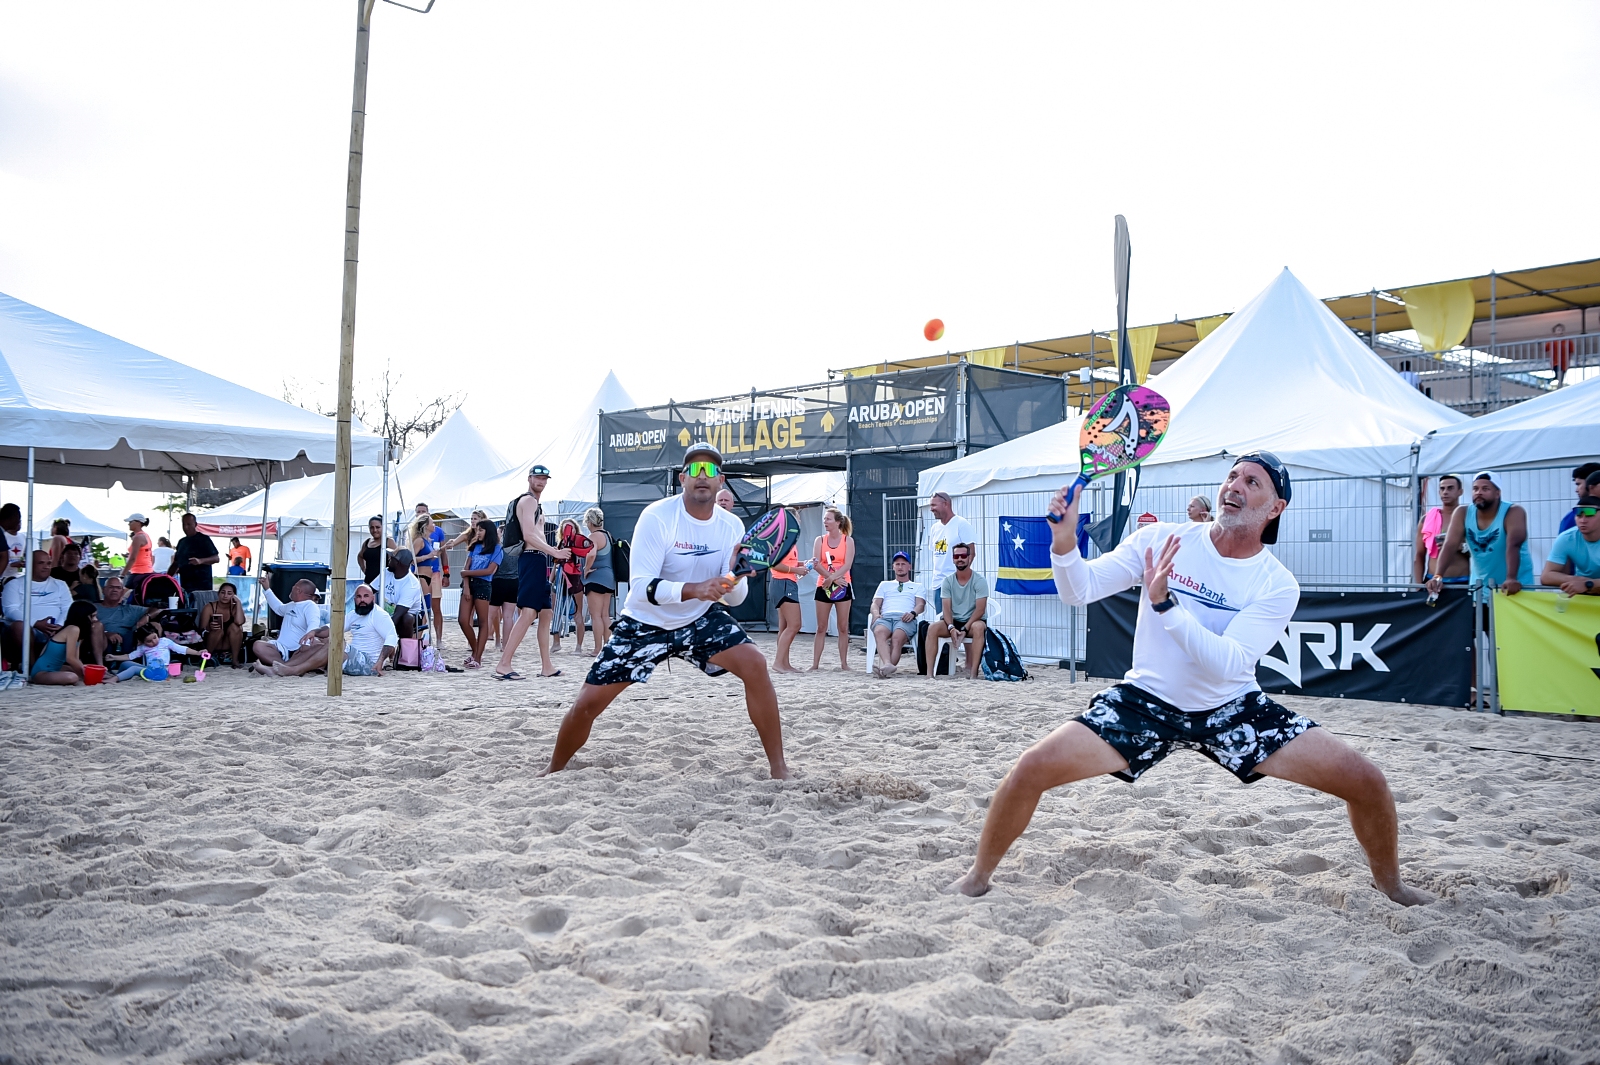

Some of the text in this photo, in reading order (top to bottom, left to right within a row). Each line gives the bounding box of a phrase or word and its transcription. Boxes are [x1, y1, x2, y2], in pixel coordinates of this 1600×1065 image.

[705, 396, 806, 427] BEACH TENNIS
[847, 396, 946, 423] ARUBA OPEN
[858, 416, 938, 429] Beach Tennis Championships
[1084, 391, 1116, 431] PREDATOR
[609, 428, 667, 448] ARUBA OPEN
[705, 415, 805, 454] VILLAGE
[743, 510, 773, 542] ATTACK
[673, 541, 709, 551] Arubabank
[1167, 569, 1227, 606] Arubabank
[1259, 621, 1392, 689] ARK
